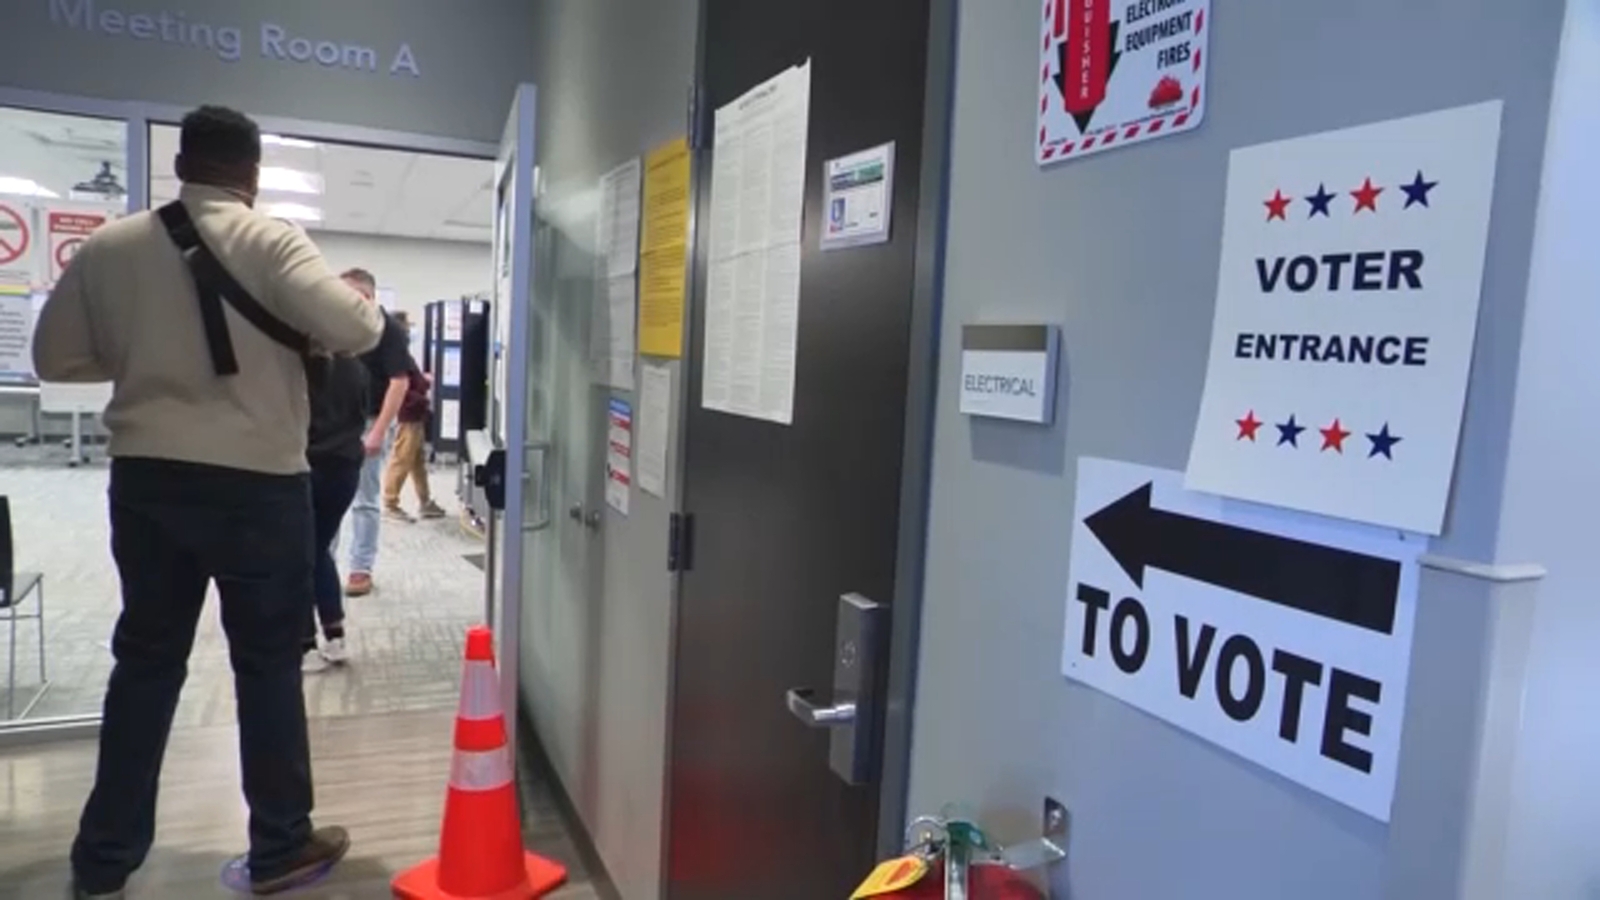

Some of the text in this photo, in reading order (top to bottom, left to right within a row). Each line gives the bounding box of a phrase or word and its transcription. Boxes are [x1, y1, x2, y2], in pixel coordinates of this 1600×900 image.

[49, 0, 420, 76] Meeting Room A
[1126, 10, 1192, 52] EQUIPMENT
[1157, 42, 1191, 69] FIRES
[1255, 250, 1424, 293] VOTER
[1235, 333, 1429, 366] ENTRANCE
[964, 374, 1036, 397] ELECTRICAL
[1076, 582, 1382, 775] TO VOTE
